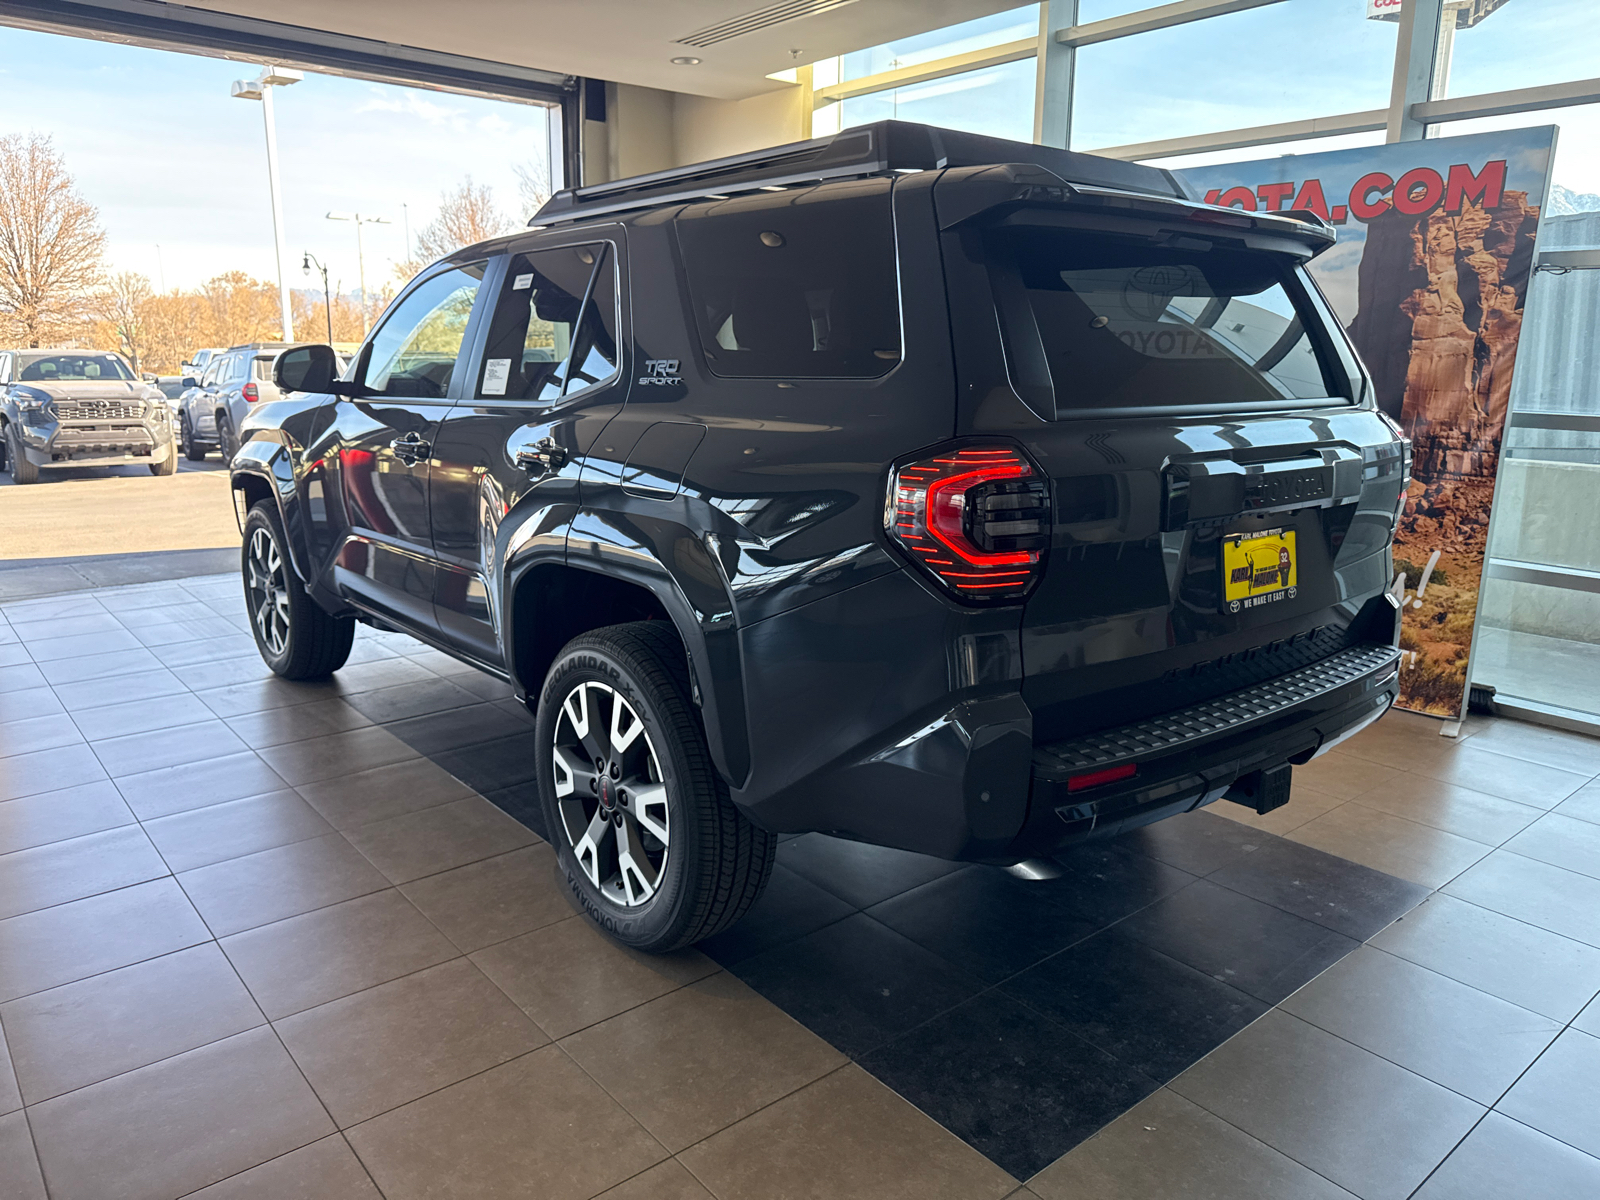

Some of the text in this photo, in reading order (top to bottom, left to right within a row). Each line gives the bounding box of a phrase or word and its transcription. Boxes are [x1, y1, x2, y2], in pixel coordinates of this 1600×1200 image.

[1114, 330, 1214, 355] OYOTA
[645, 359, 680, 377] TRD
[638, 376, 682, 385] SPORT
[1280, 552, 1288, 563] 32
[1244, 590, 1285, 608] WE MAKE IT EASY
[544, 655, 621, 705] GEOLANDAR
[567, 871, 621, 937] YOKOHAMA
